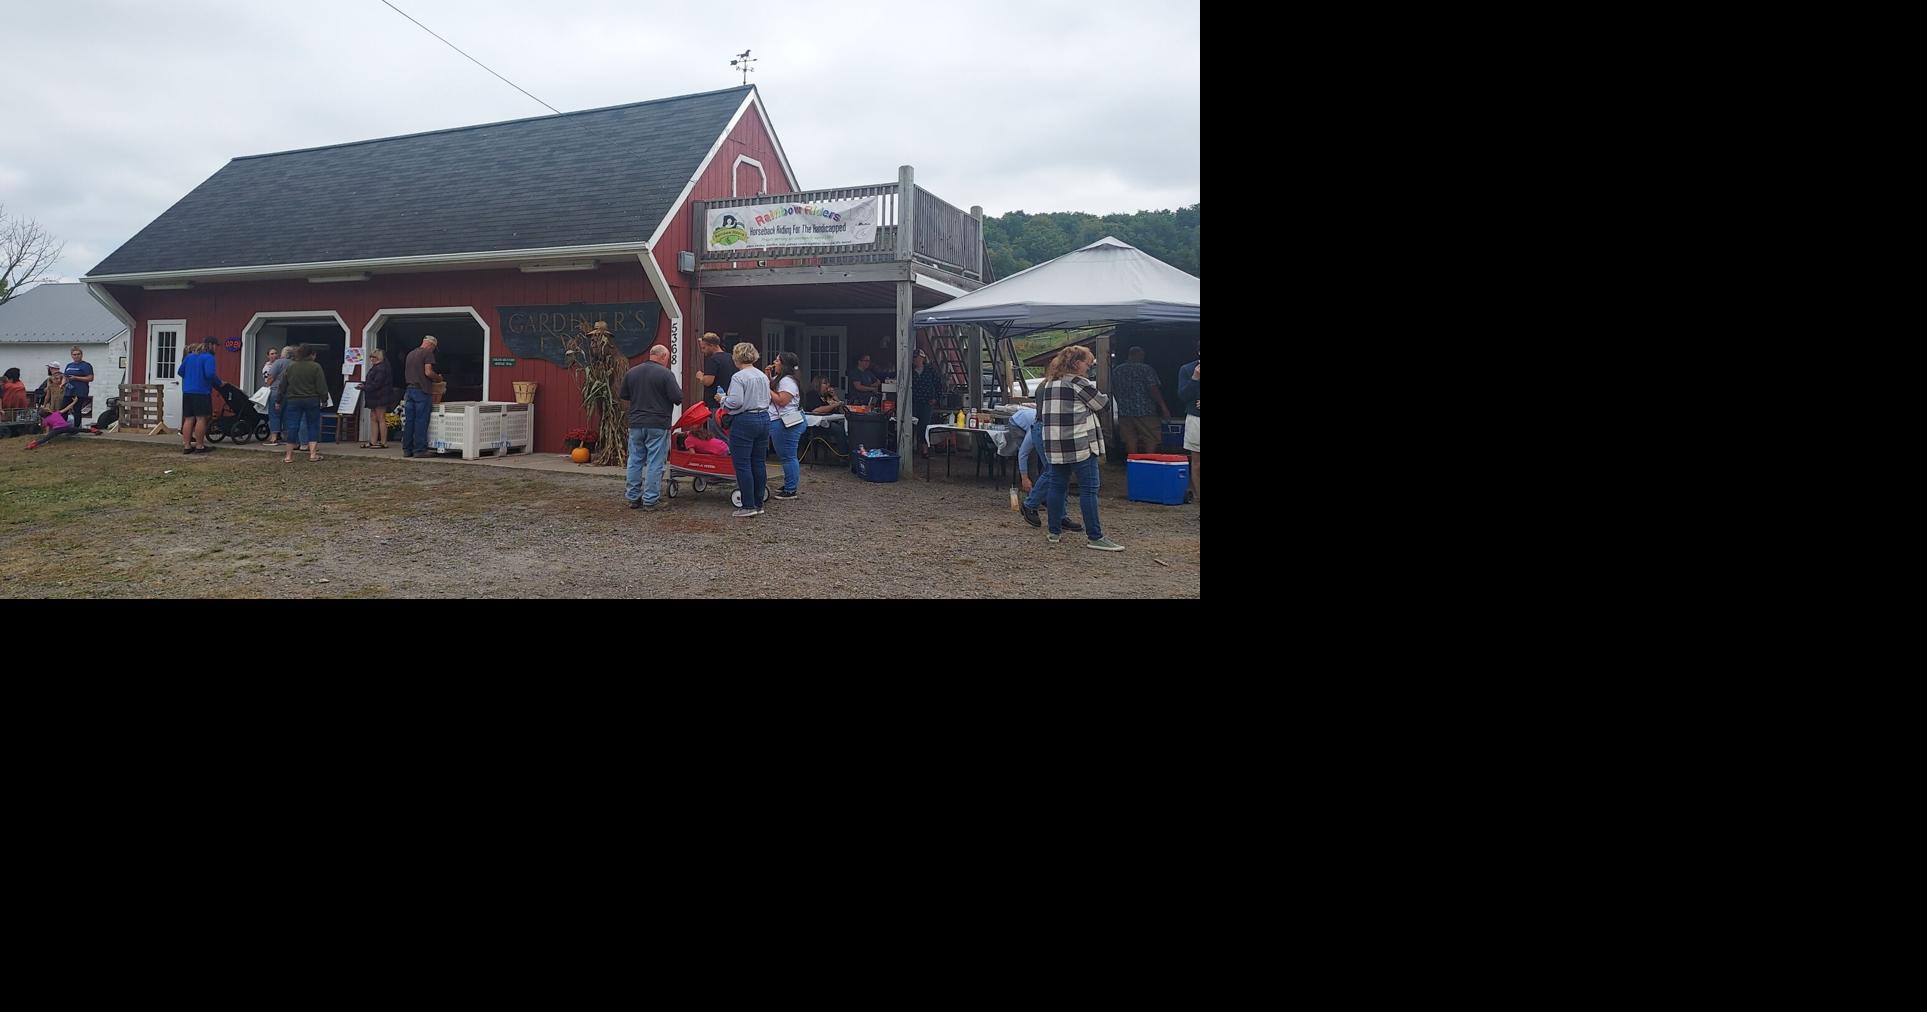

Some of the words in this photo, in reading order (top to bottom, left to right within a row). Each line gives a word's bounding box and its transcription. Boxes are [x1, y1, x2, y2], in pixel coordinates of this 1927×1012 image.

[755, 205, 801, 226] Rainbow
[804, 204, 842, 222] Riders
[750, 226, 775, 235] Horseback
[776, 225, 792, 235] Riding
[802, 224, 812, 233] The
[813, 223, 846, 234] Handicapped
